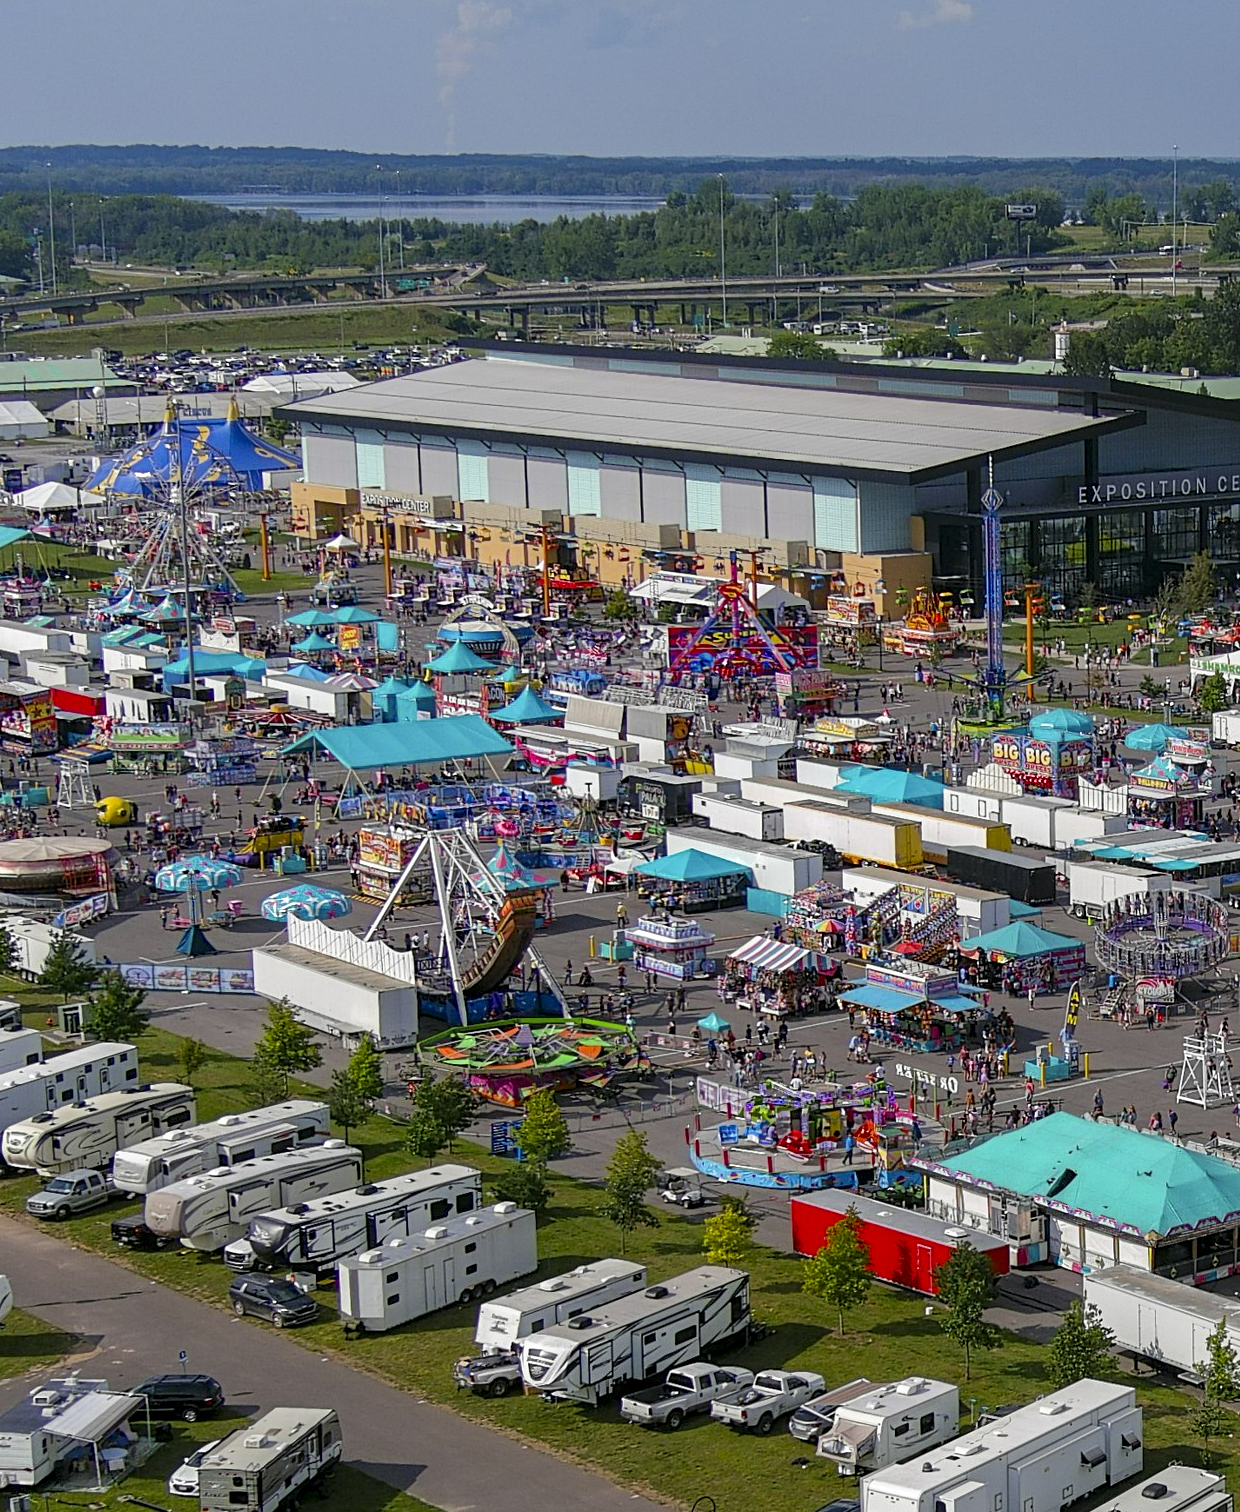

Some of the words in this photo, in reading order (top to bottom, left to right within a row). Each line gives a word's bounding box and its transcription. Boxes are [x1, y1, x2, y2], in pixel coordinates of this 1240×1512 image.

[1078, 477, 1206, 504] EXPOSITION
[402, 496, 431, 513] CENTER
[711, 631, 759, 643] SUER
[992, 741, 1019, 760] BIG
[1025, 747, 1052, 766] BIG
[1060, 749, 1092, 767] BIG
[1066, 990, 1079, 1026] ATM
[1071, 1046, 1079, 1066] ATM
